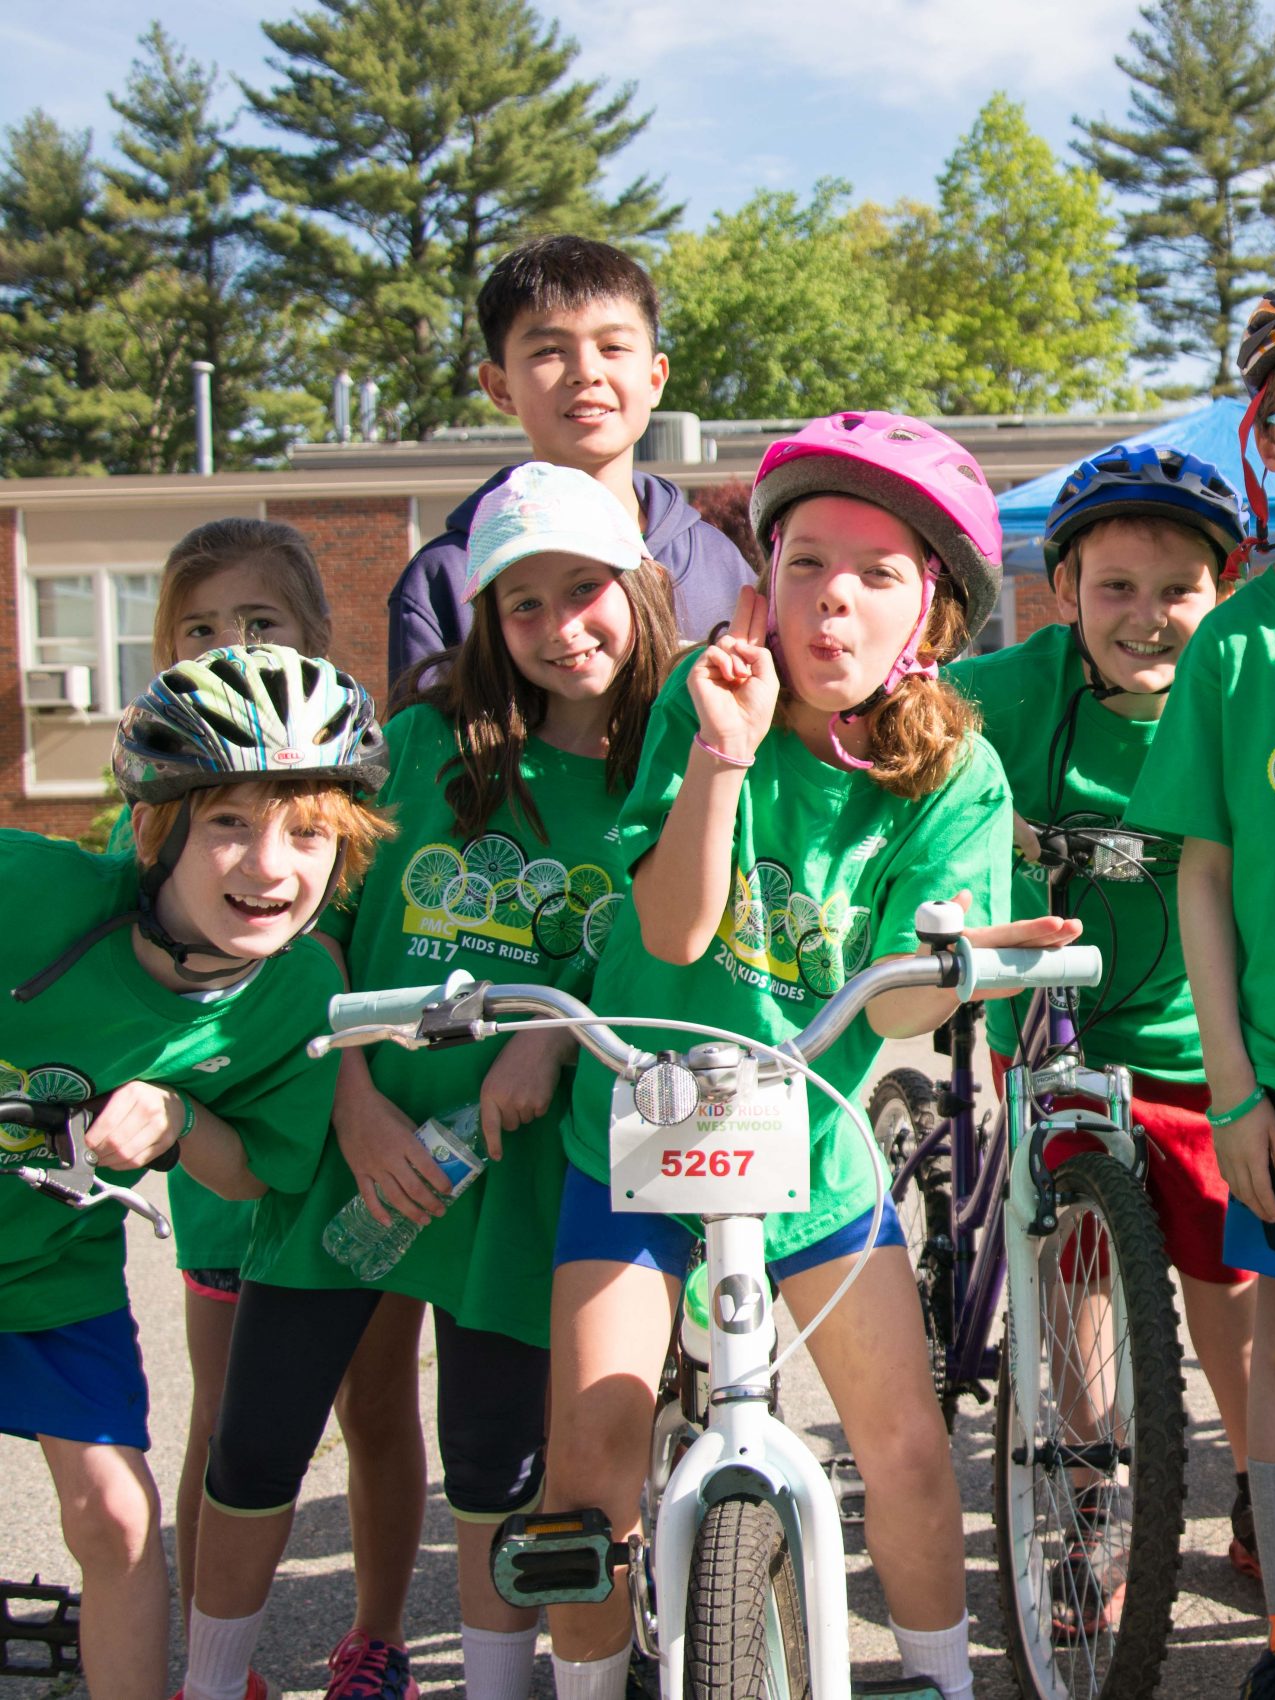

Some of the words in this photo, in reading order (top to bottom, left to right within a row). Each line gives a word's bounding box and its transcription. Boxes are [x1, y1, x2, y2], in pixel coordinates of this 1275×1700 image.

[407, 936, 459, 963] 2017
[420, 917, 455, 936] PMC
[461, 935, 495, 953] KIDS
[499, 947, 540, 964] RIDES
[738, 964, 769, 988] KIDS
[769, 979, 805, 1000] RIDES
[698, 1104, 733, 1117] KIDS
[738, 1104, 780, 1117] RIDES
[697, 1120, 783, 1132] WESTWOOD
[661, 1149, 755, 1177] 5267
